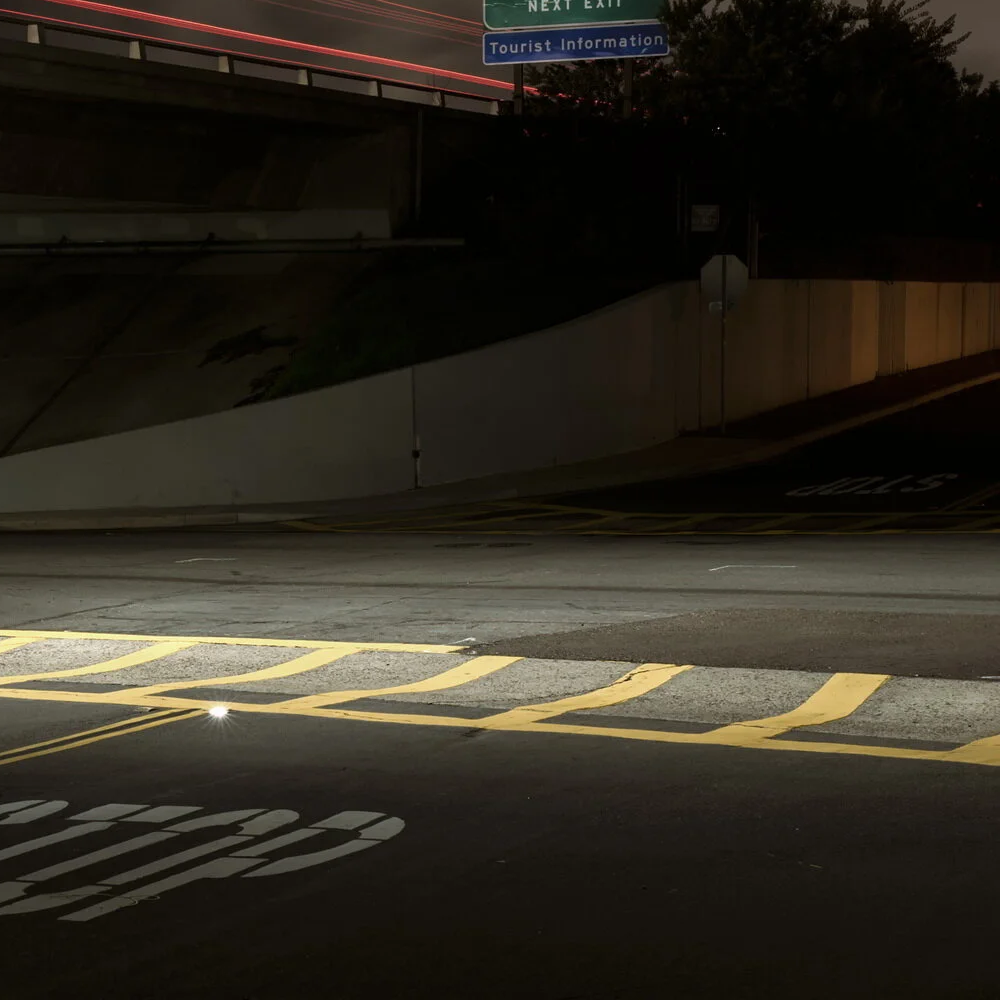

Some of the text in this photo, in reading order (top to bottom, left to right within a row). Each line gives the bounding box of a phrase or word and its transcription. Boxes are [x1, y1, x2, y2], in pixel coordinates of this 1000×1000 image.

[489, 33, 664, 56] Tourist Information
[784, 472, 959, 497] STOP
